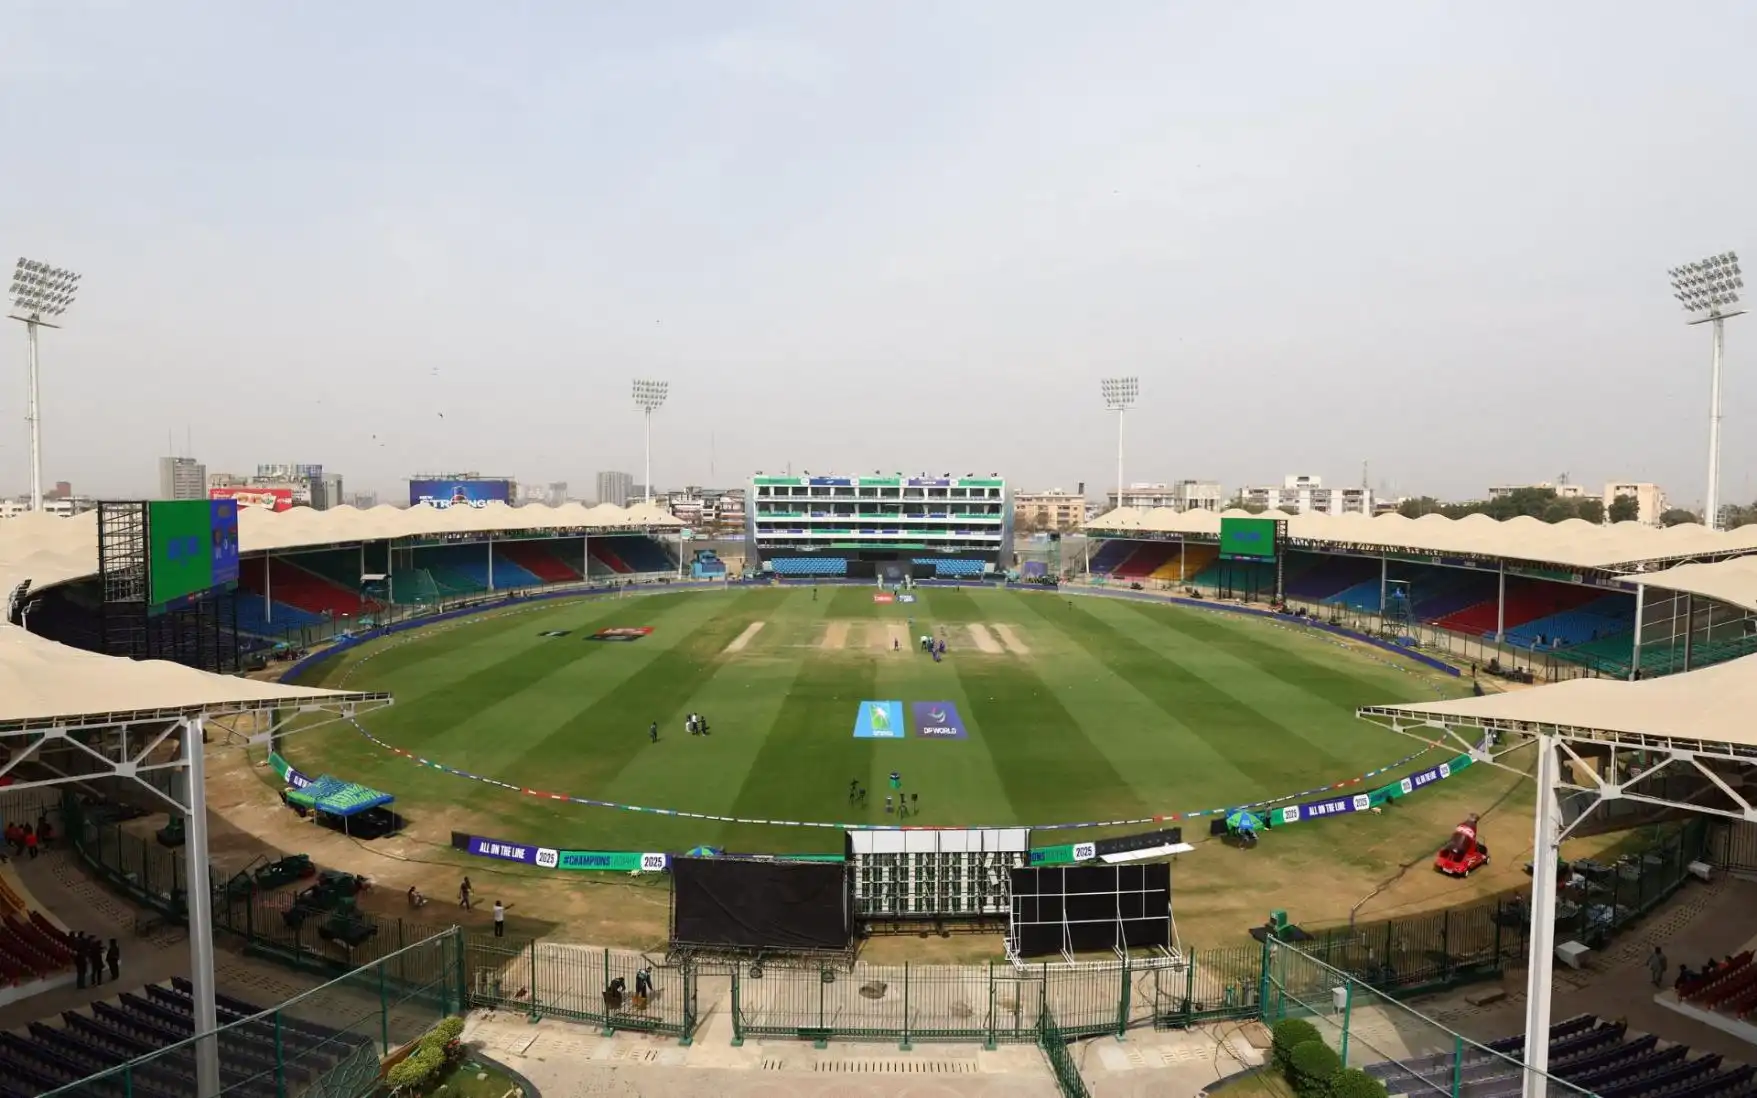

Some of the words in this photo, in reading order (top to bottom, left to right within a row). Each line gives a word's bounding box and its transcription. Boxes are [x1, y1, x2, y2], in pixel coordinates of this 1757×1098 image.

[1308, 806, 1318, 816] ALL
[1318, 804, 1326, 815] ON
[1325, 803, 1336, 813] THE
[1335, 801, 1346, 812] LINE
[479, 841, 490, 854] ALL
[490, 843, 500, 855] ON
[500, 845, 512, 857] THE
[512, 847, 526, 859] LINE
[1076, 846, 1093, 858] 2025
[538, 852, 555, 864] 2025
[644, 856, 663, 868] 2025
